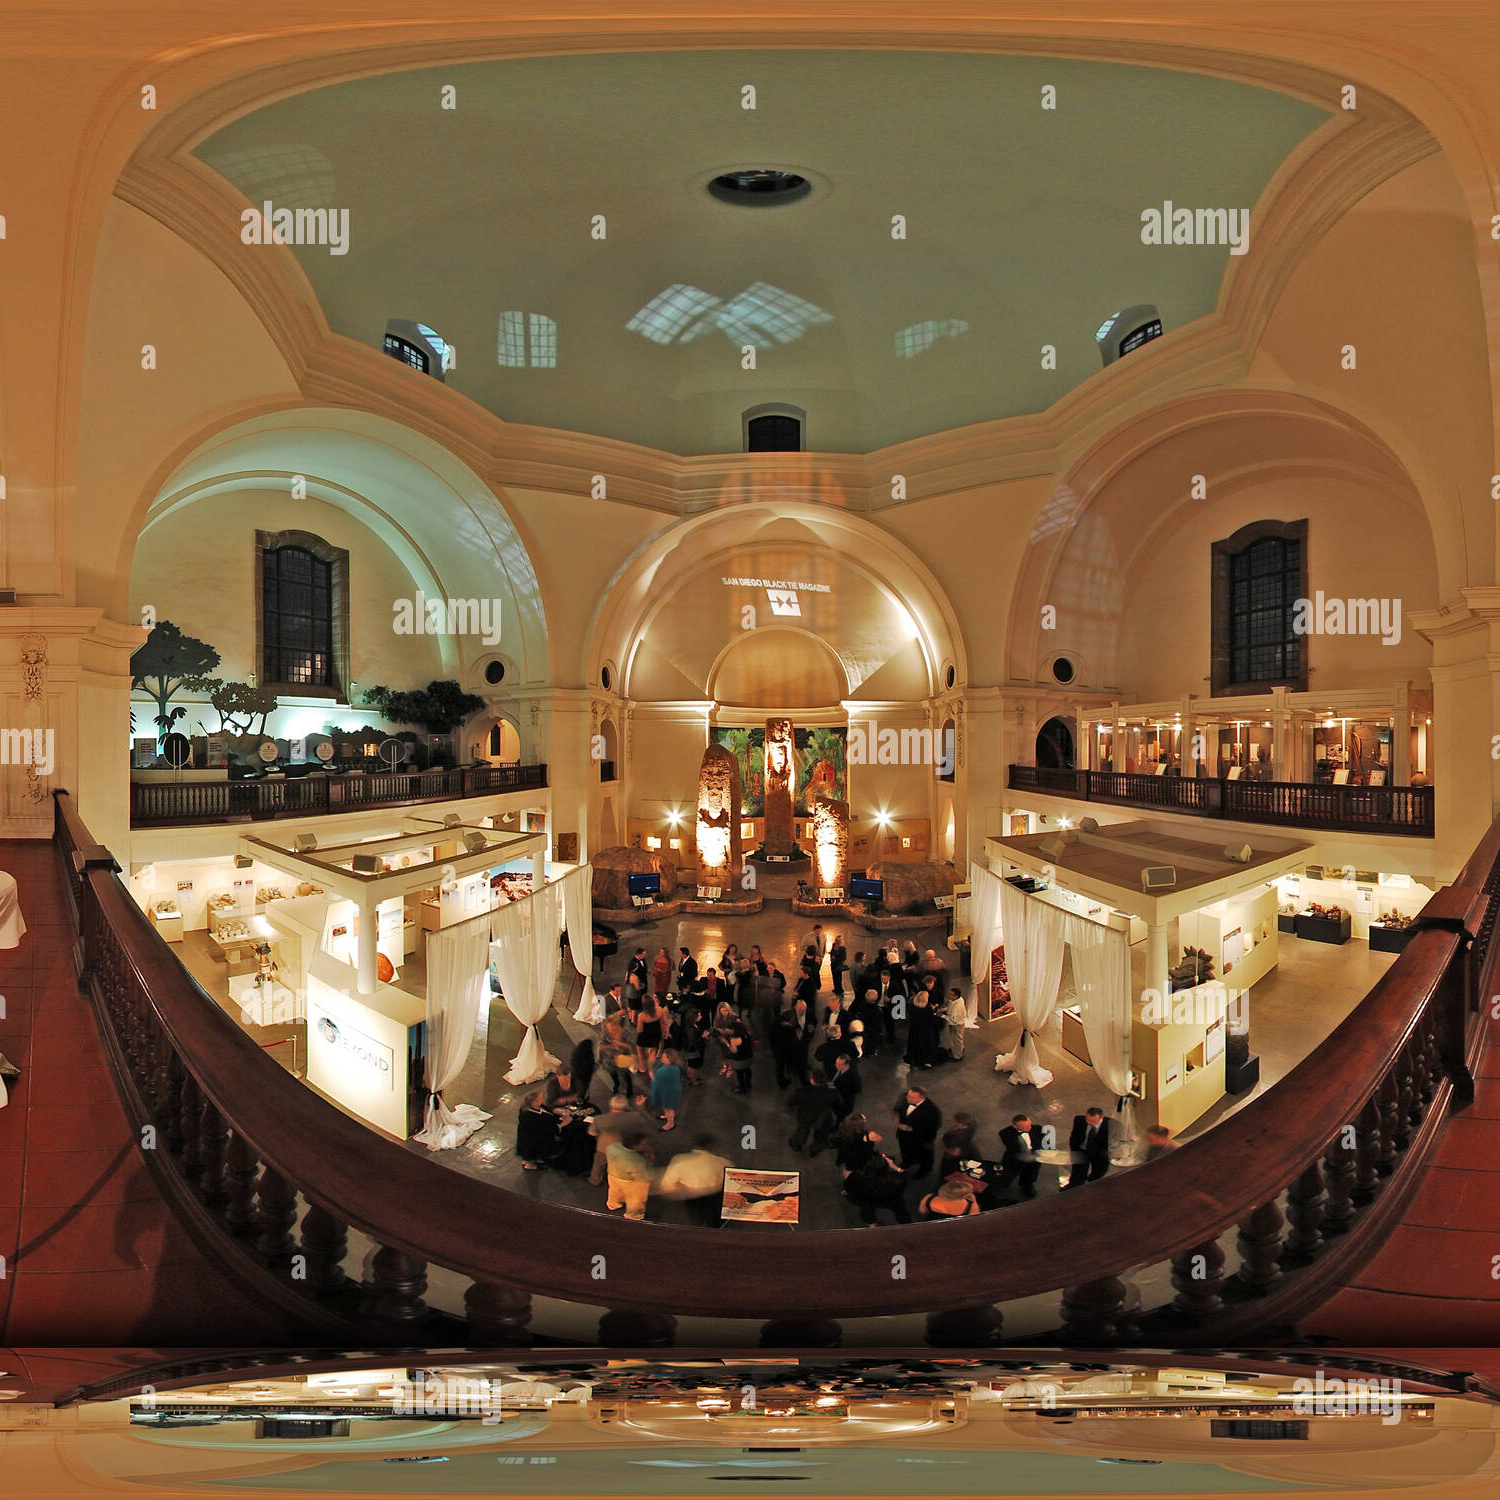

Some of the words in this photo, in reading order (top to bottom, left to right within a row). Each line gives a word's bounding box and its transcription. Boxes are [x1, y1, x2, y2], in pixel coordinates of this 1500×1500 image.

[722, 577, 739, 586] SAN
[739, 578, 763, 588] DIEGO
[763, 579, 787, 588] BLACK
[336, 1033, 389, 1072] EYOND
